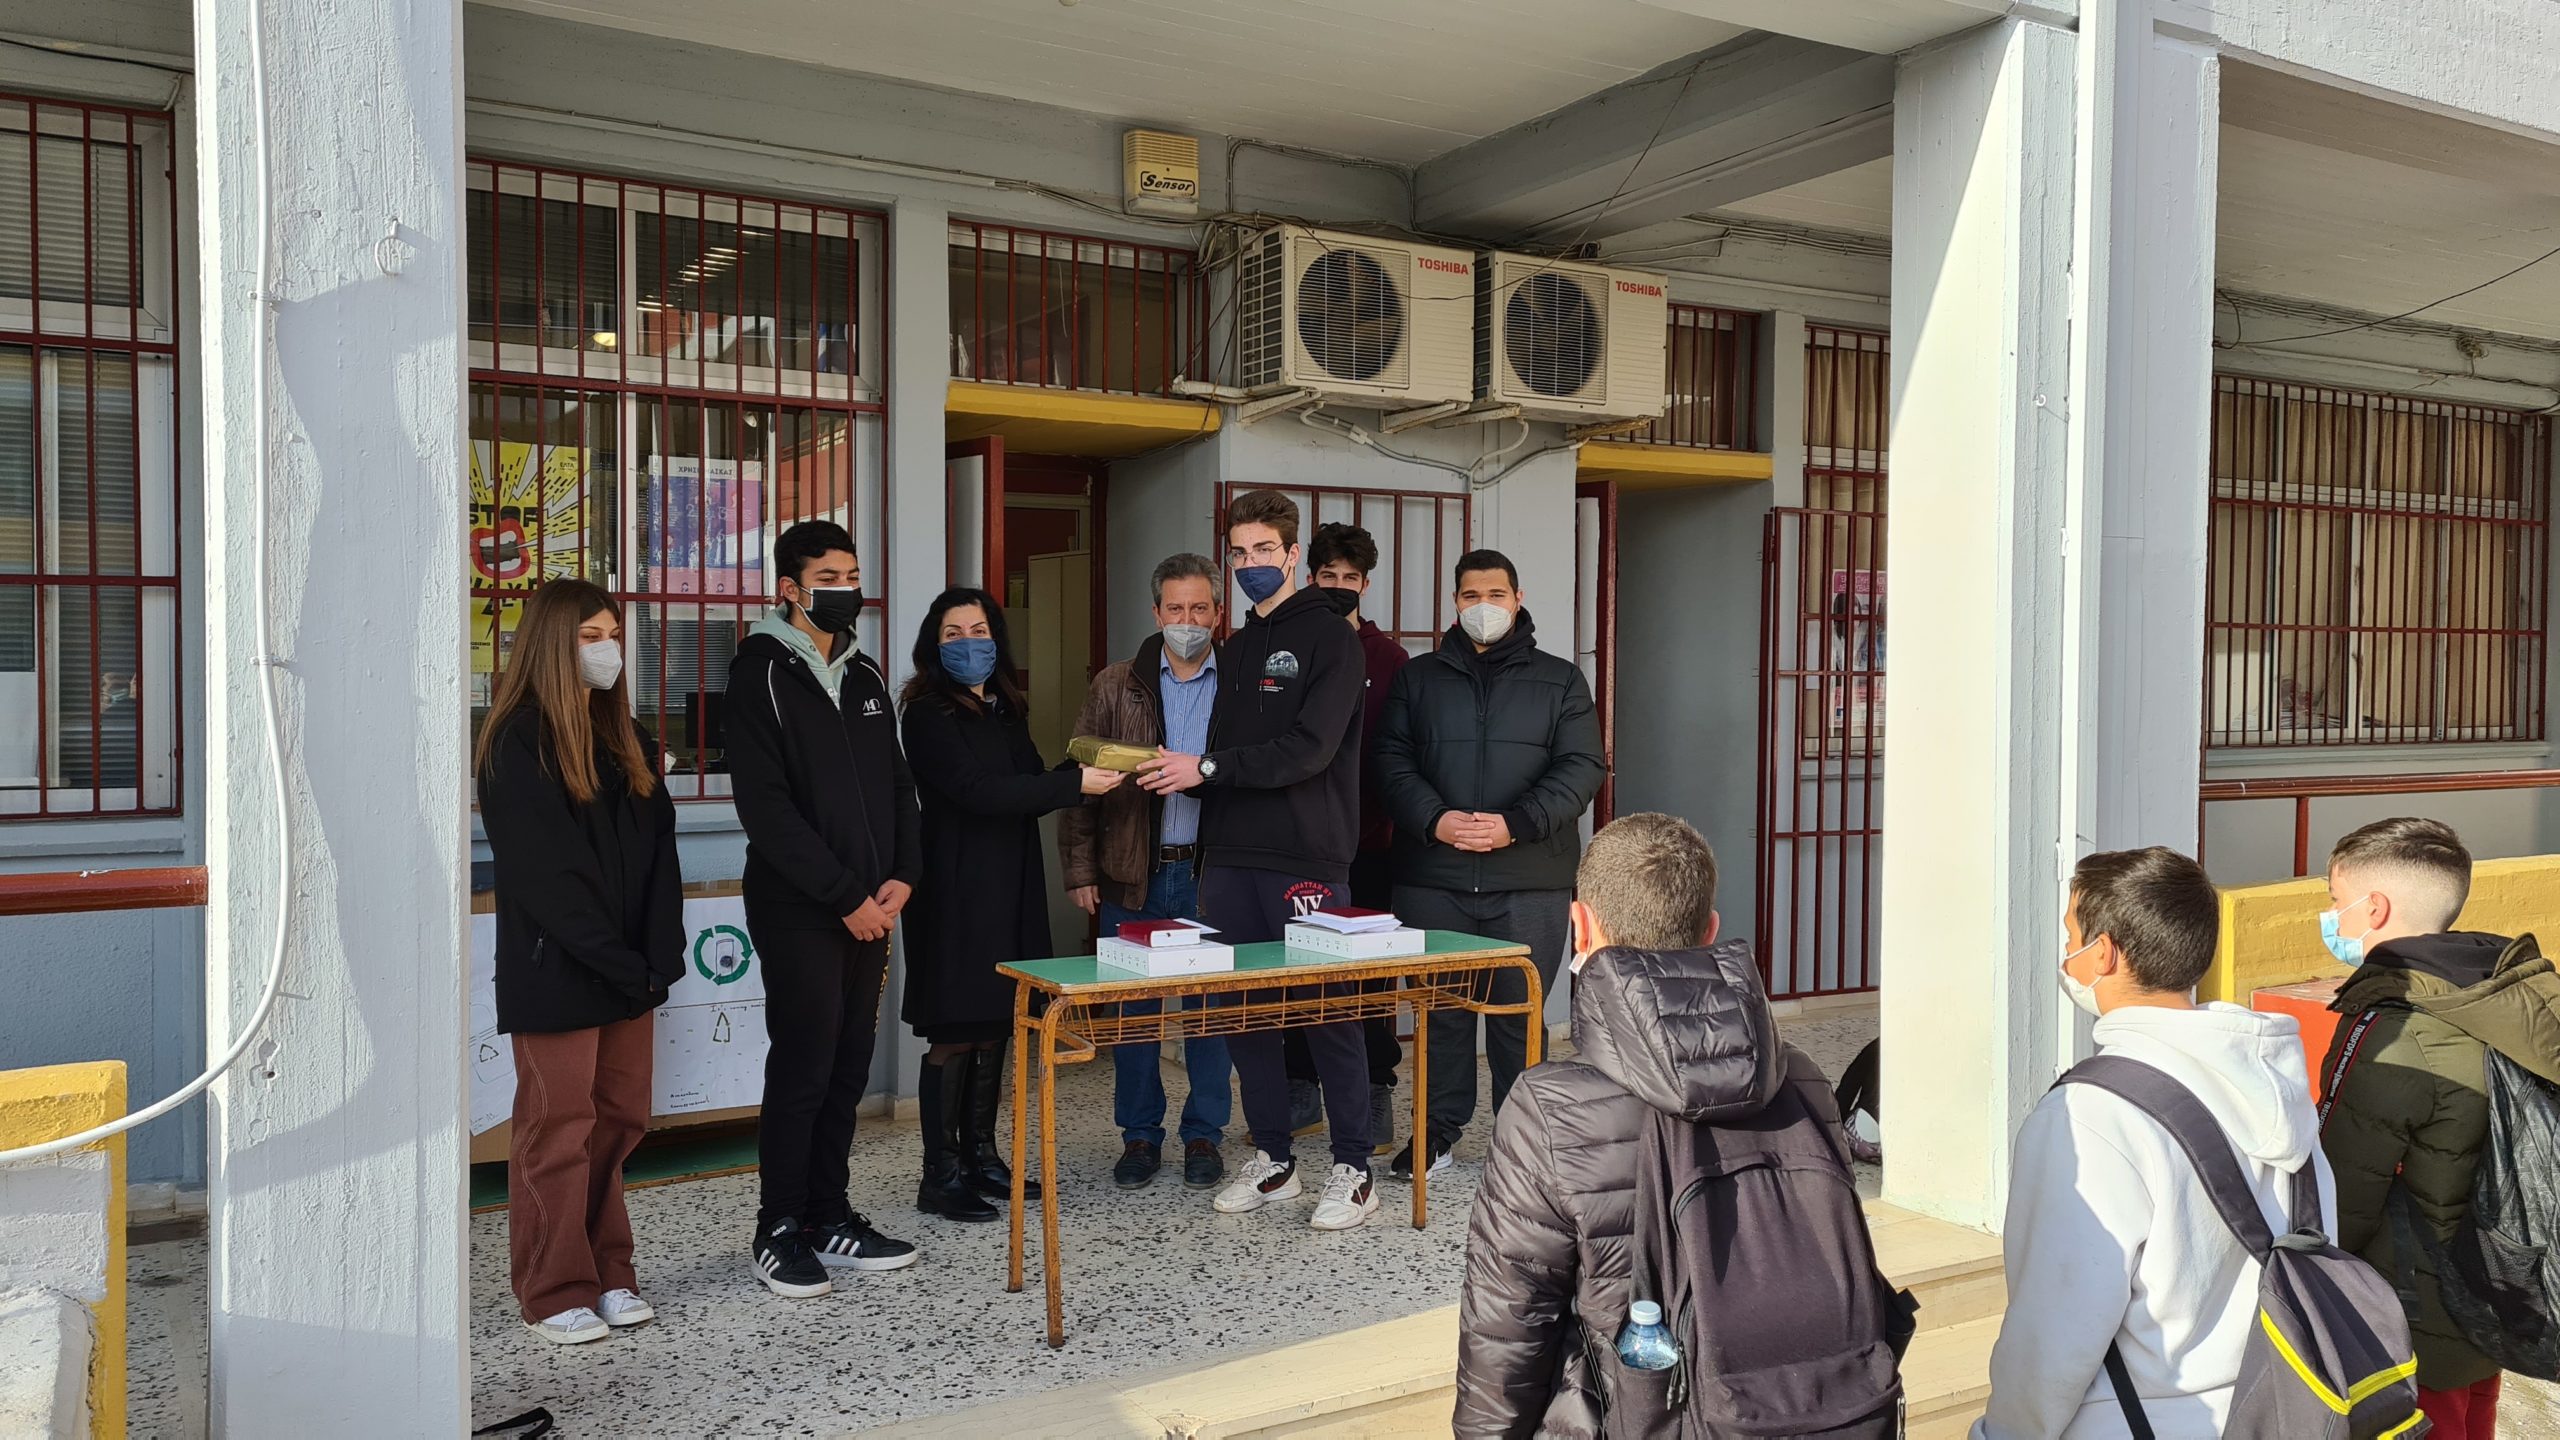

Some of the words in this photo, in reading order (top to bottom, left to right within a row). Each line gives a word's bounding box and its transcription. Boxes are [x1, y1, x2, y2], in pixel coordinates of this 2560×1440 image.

[1143, 174, 1193, 191] Sensor
[1417, 257, 1469, 275] TOSHIBA
[1615, 280, 1662, 297] TOSHIBA
